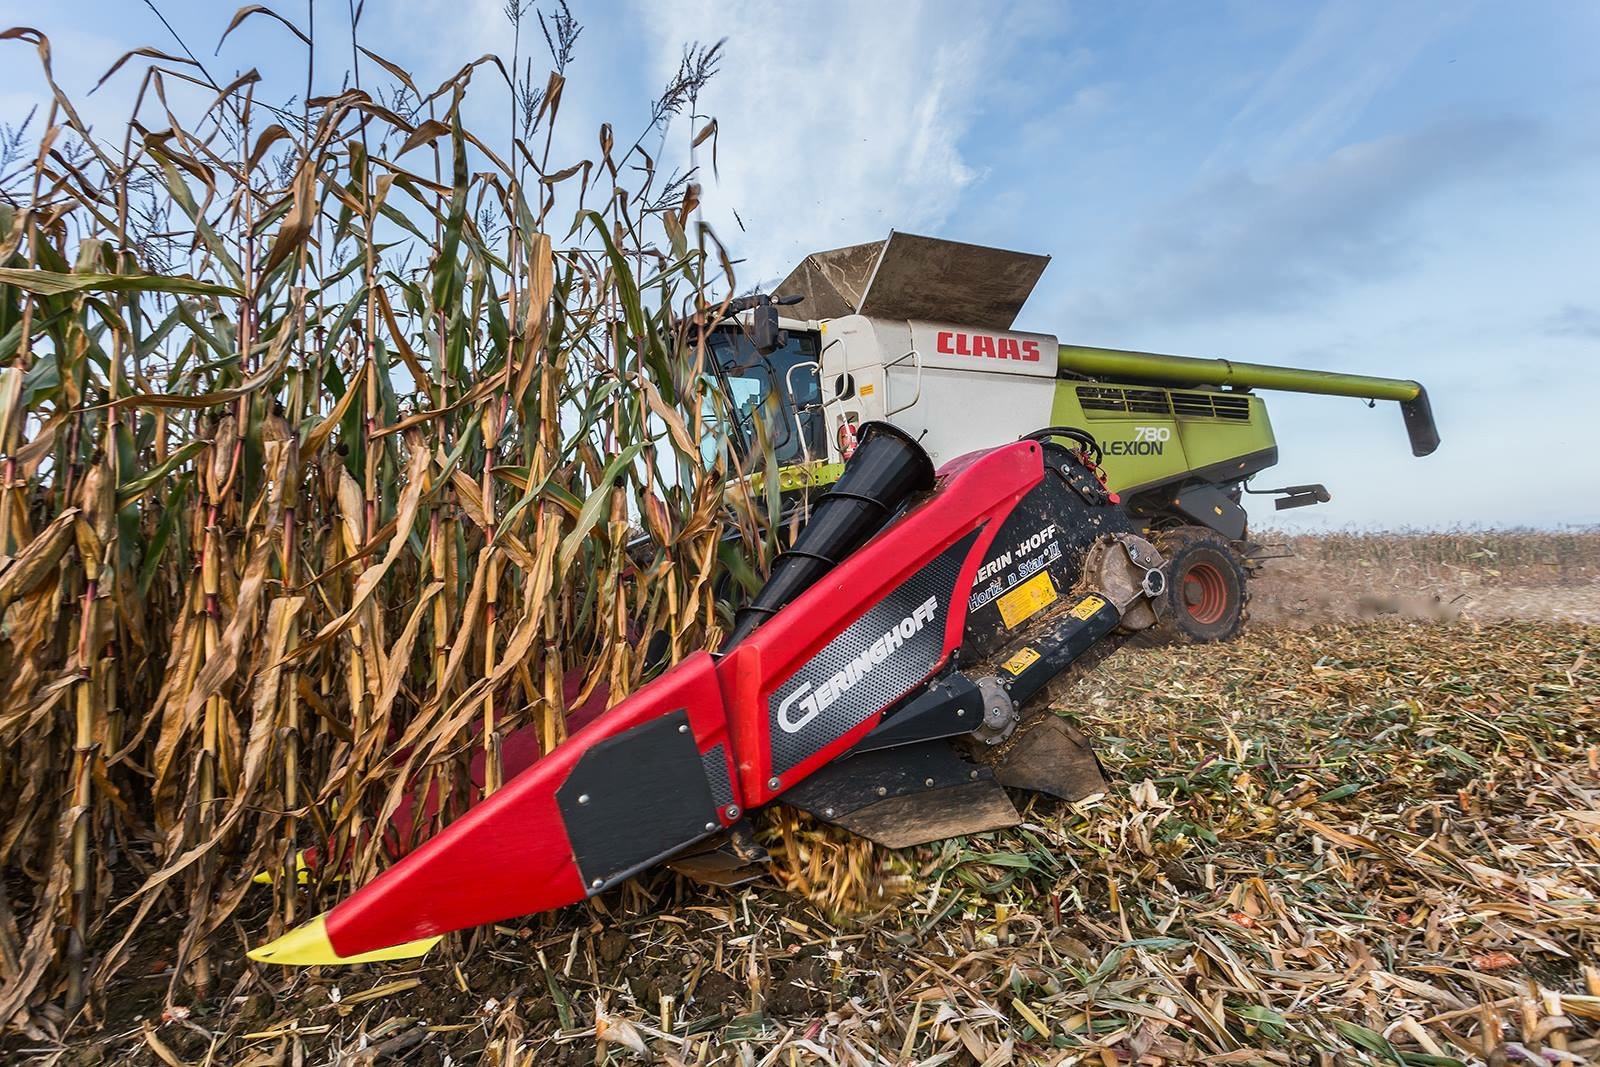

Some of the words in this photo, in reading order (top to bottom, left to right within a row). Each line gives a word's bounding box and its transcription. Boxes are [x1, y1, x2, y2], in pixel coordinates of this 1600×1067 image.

[937, 331, 1040, 362] CLAAS
[1102, 441, 1163, 456] LEXION
[1134, 427, 1170, 442] 780
[968, 572, 1018, 611] Horizn
[777, 595, 938, 733] GERINGHOFF
